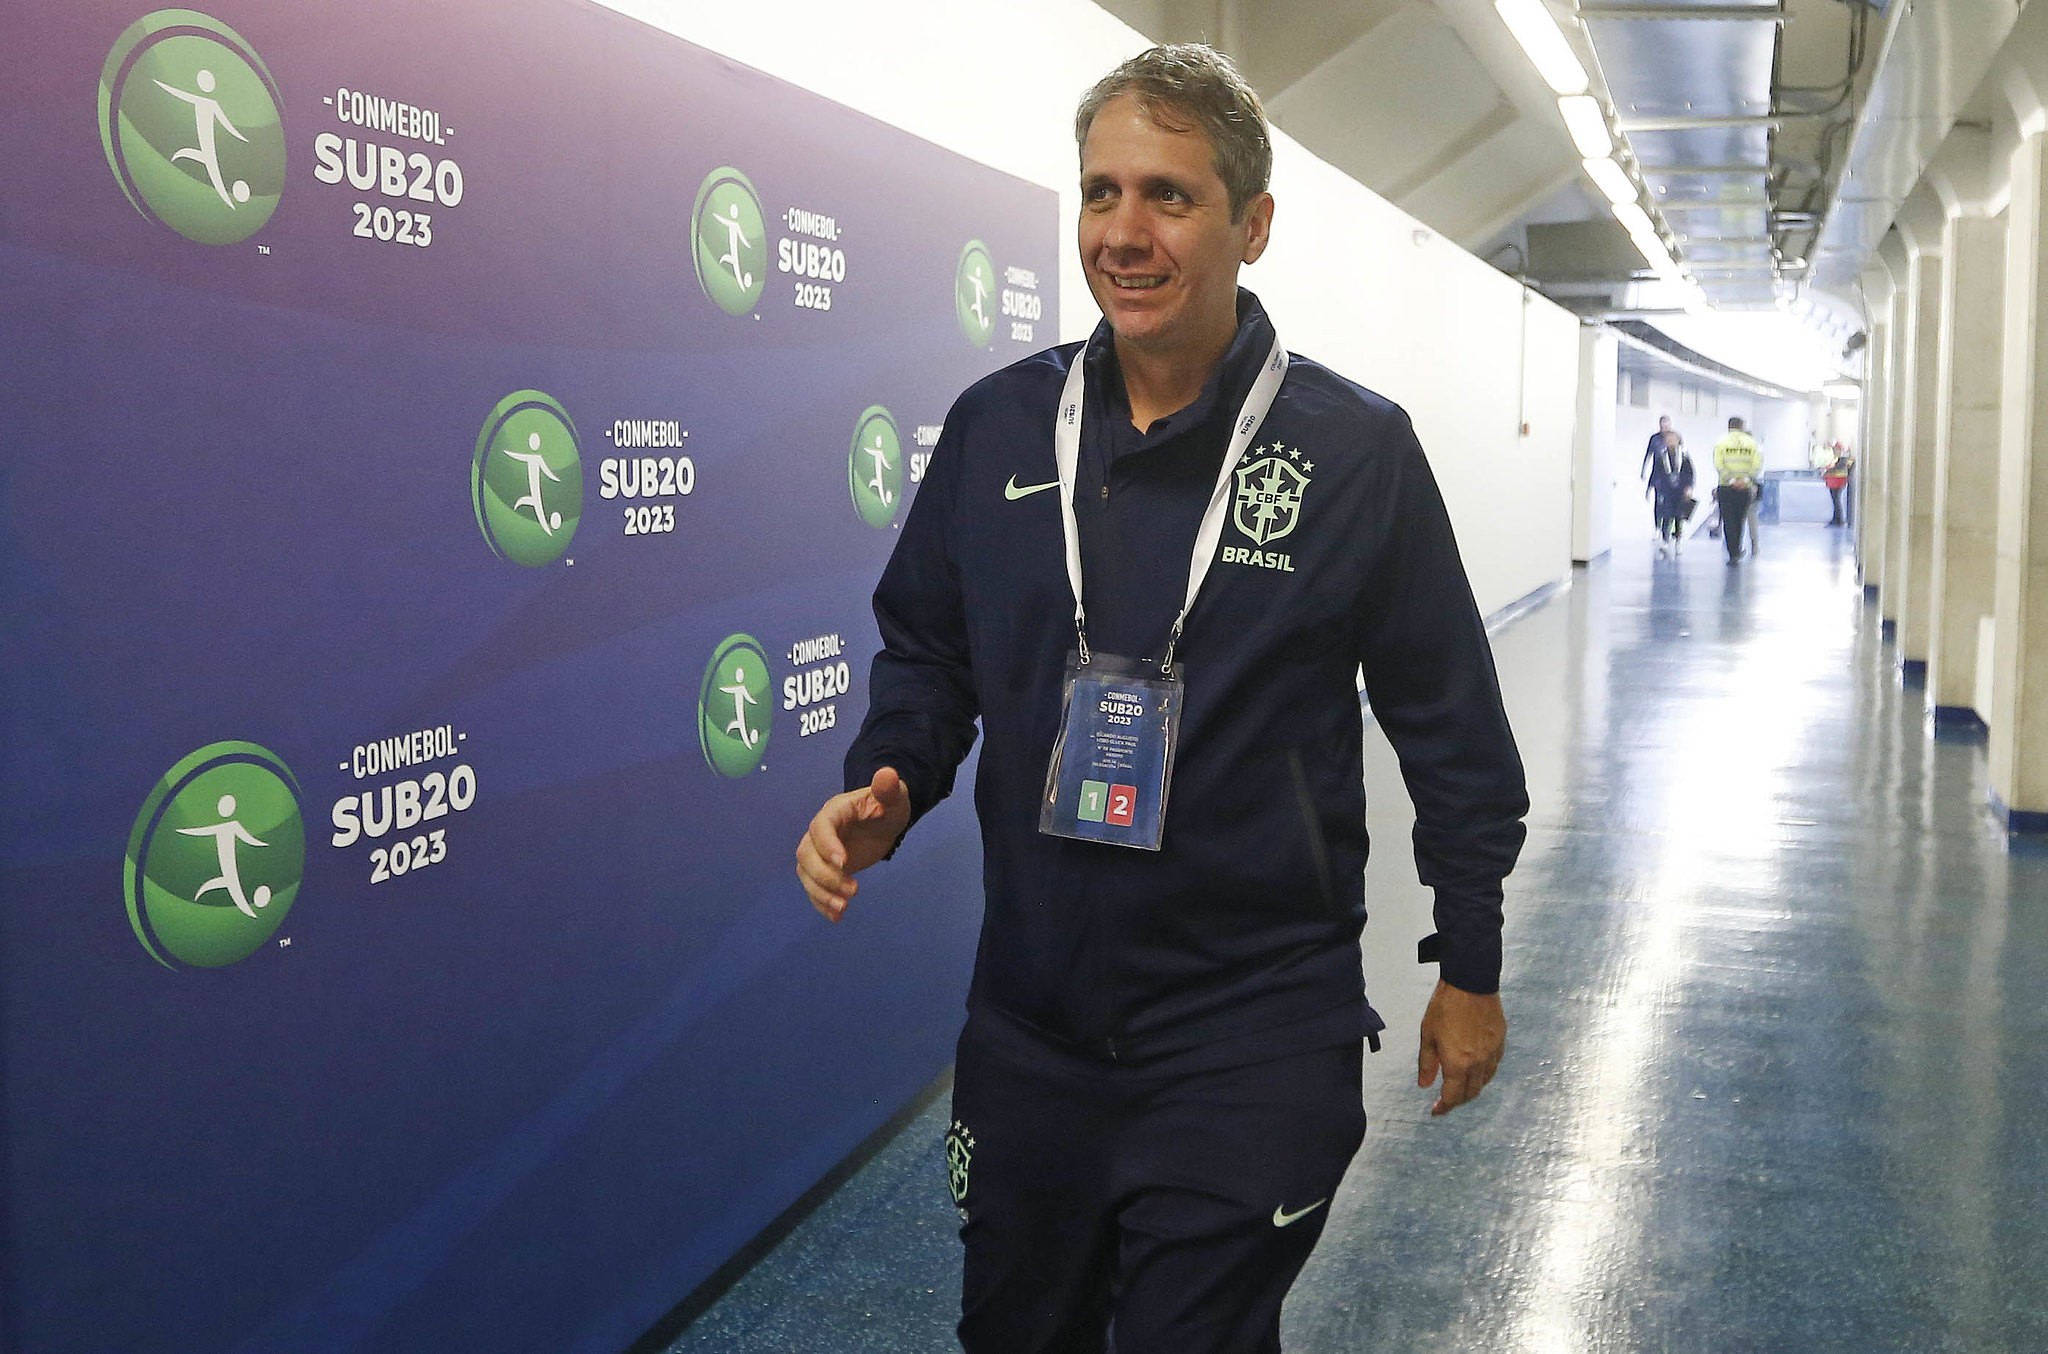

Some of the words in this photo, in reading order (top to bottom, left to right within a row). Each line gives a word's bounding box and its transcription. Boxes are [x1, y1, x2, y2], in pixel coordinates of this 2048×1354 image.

[313, 132, 465, 208] SUB20
[353, 202, 433, 248] 2023
[778, 237, 846, 283] SUB20
[794, 282, 832, 311] 2023
[599, 456, 696, 500] SUB20
[1255, 492, 1283, 505] CBF
[623, 504, 675, 536] 2023
[1222, 546, 1296, 573] BRASIL
[782, 661, 851, 712] SUB20
[800, 704, 837, 738] 2023
[1099, 700, 1144, 717] SUB20
[1107, 715, 1132, 726] 2023
[331, 763, 478, 849] SUB20
[1088, 791, 1099, 811] 1
[1113, 795, 1129, 816] 2
[369, 828, 448, 885] 2023
